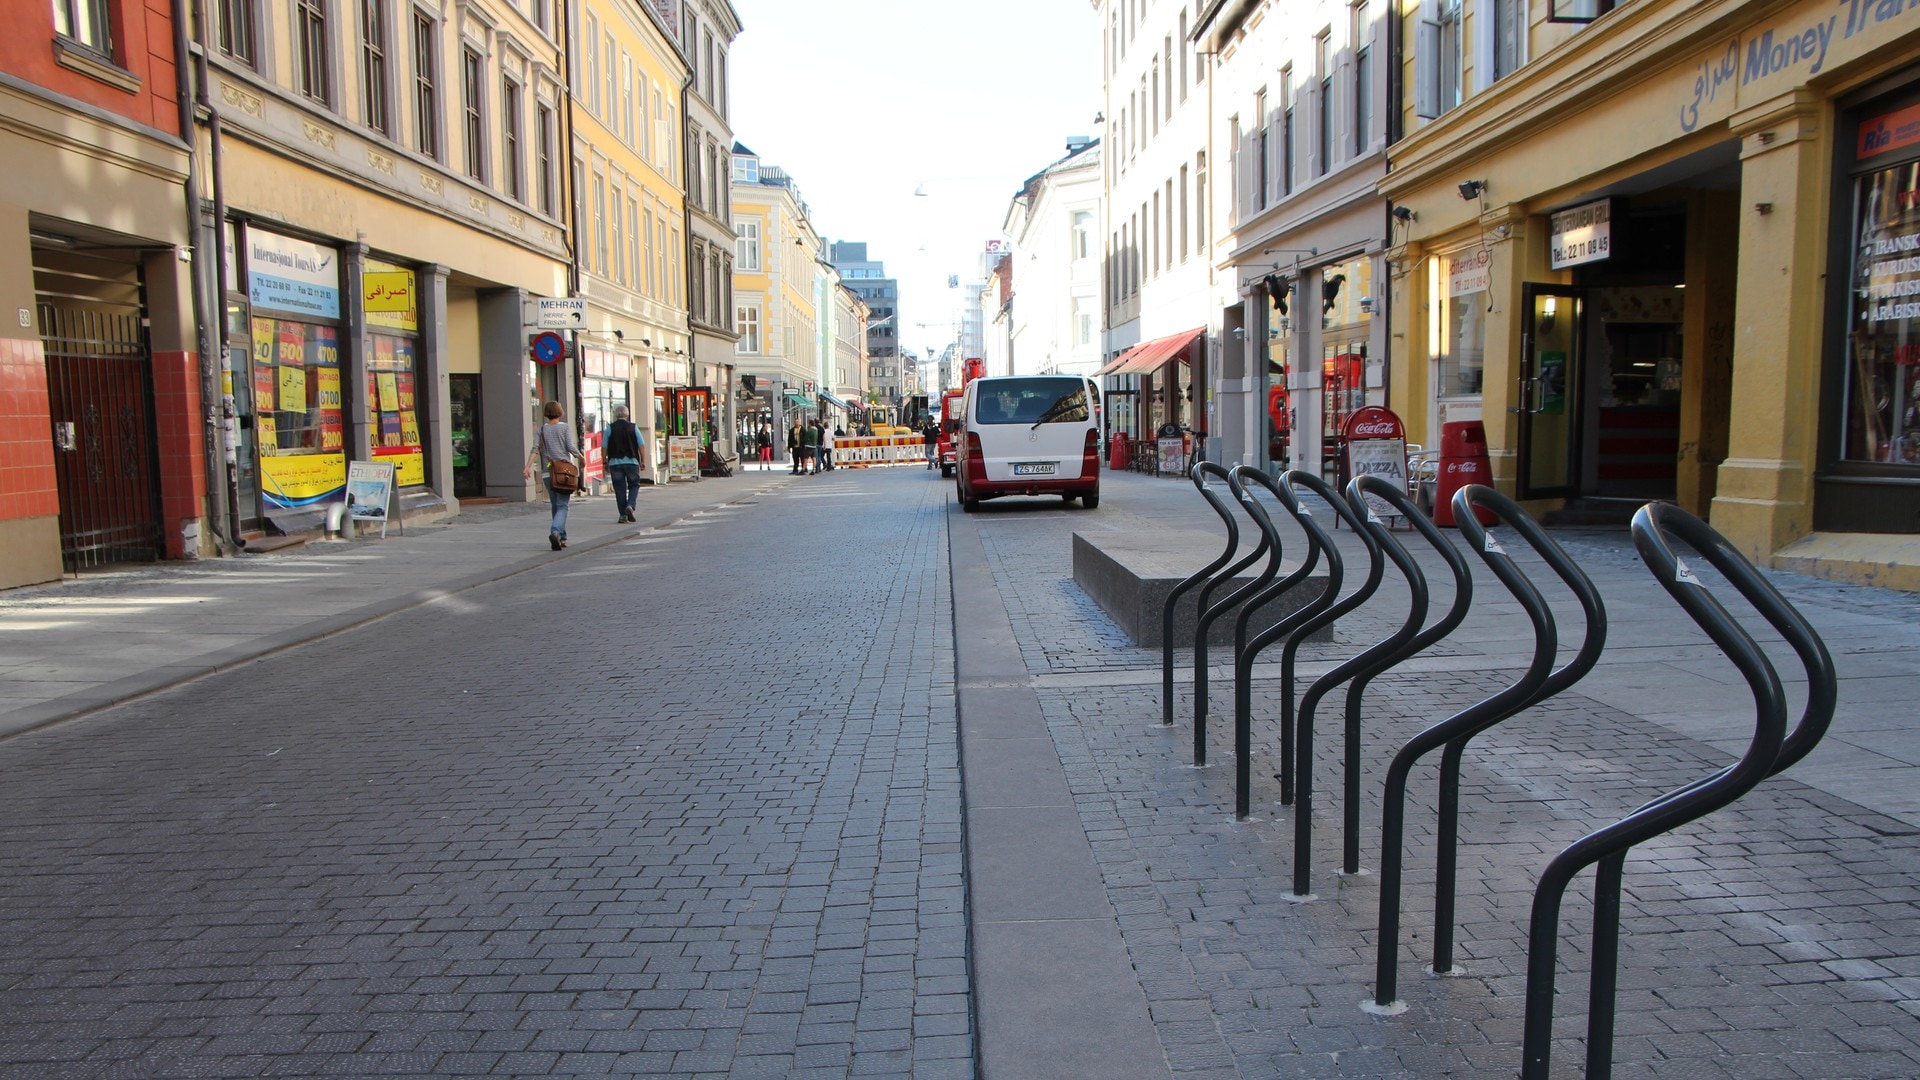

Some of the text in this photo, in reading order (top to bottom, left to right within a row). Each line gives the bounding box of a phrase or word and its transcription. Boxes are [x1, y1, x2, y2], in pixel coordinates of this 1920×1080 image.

[1743, 15, 1836, 86] Money
[1863, 122, 1891, 152] Ria
[1568, 244, 1577, 259] 22
[1579, 241, 1586, 257] 11
[1588, 239, 1597, 254] 09
[1598, 236, 1608, 252] 45
[540, 300, 583, 309] MEHRAN
[1355, 422, 1395, 435] Coca-Cola
[1355, 461, 1404, 479] PIZZA
